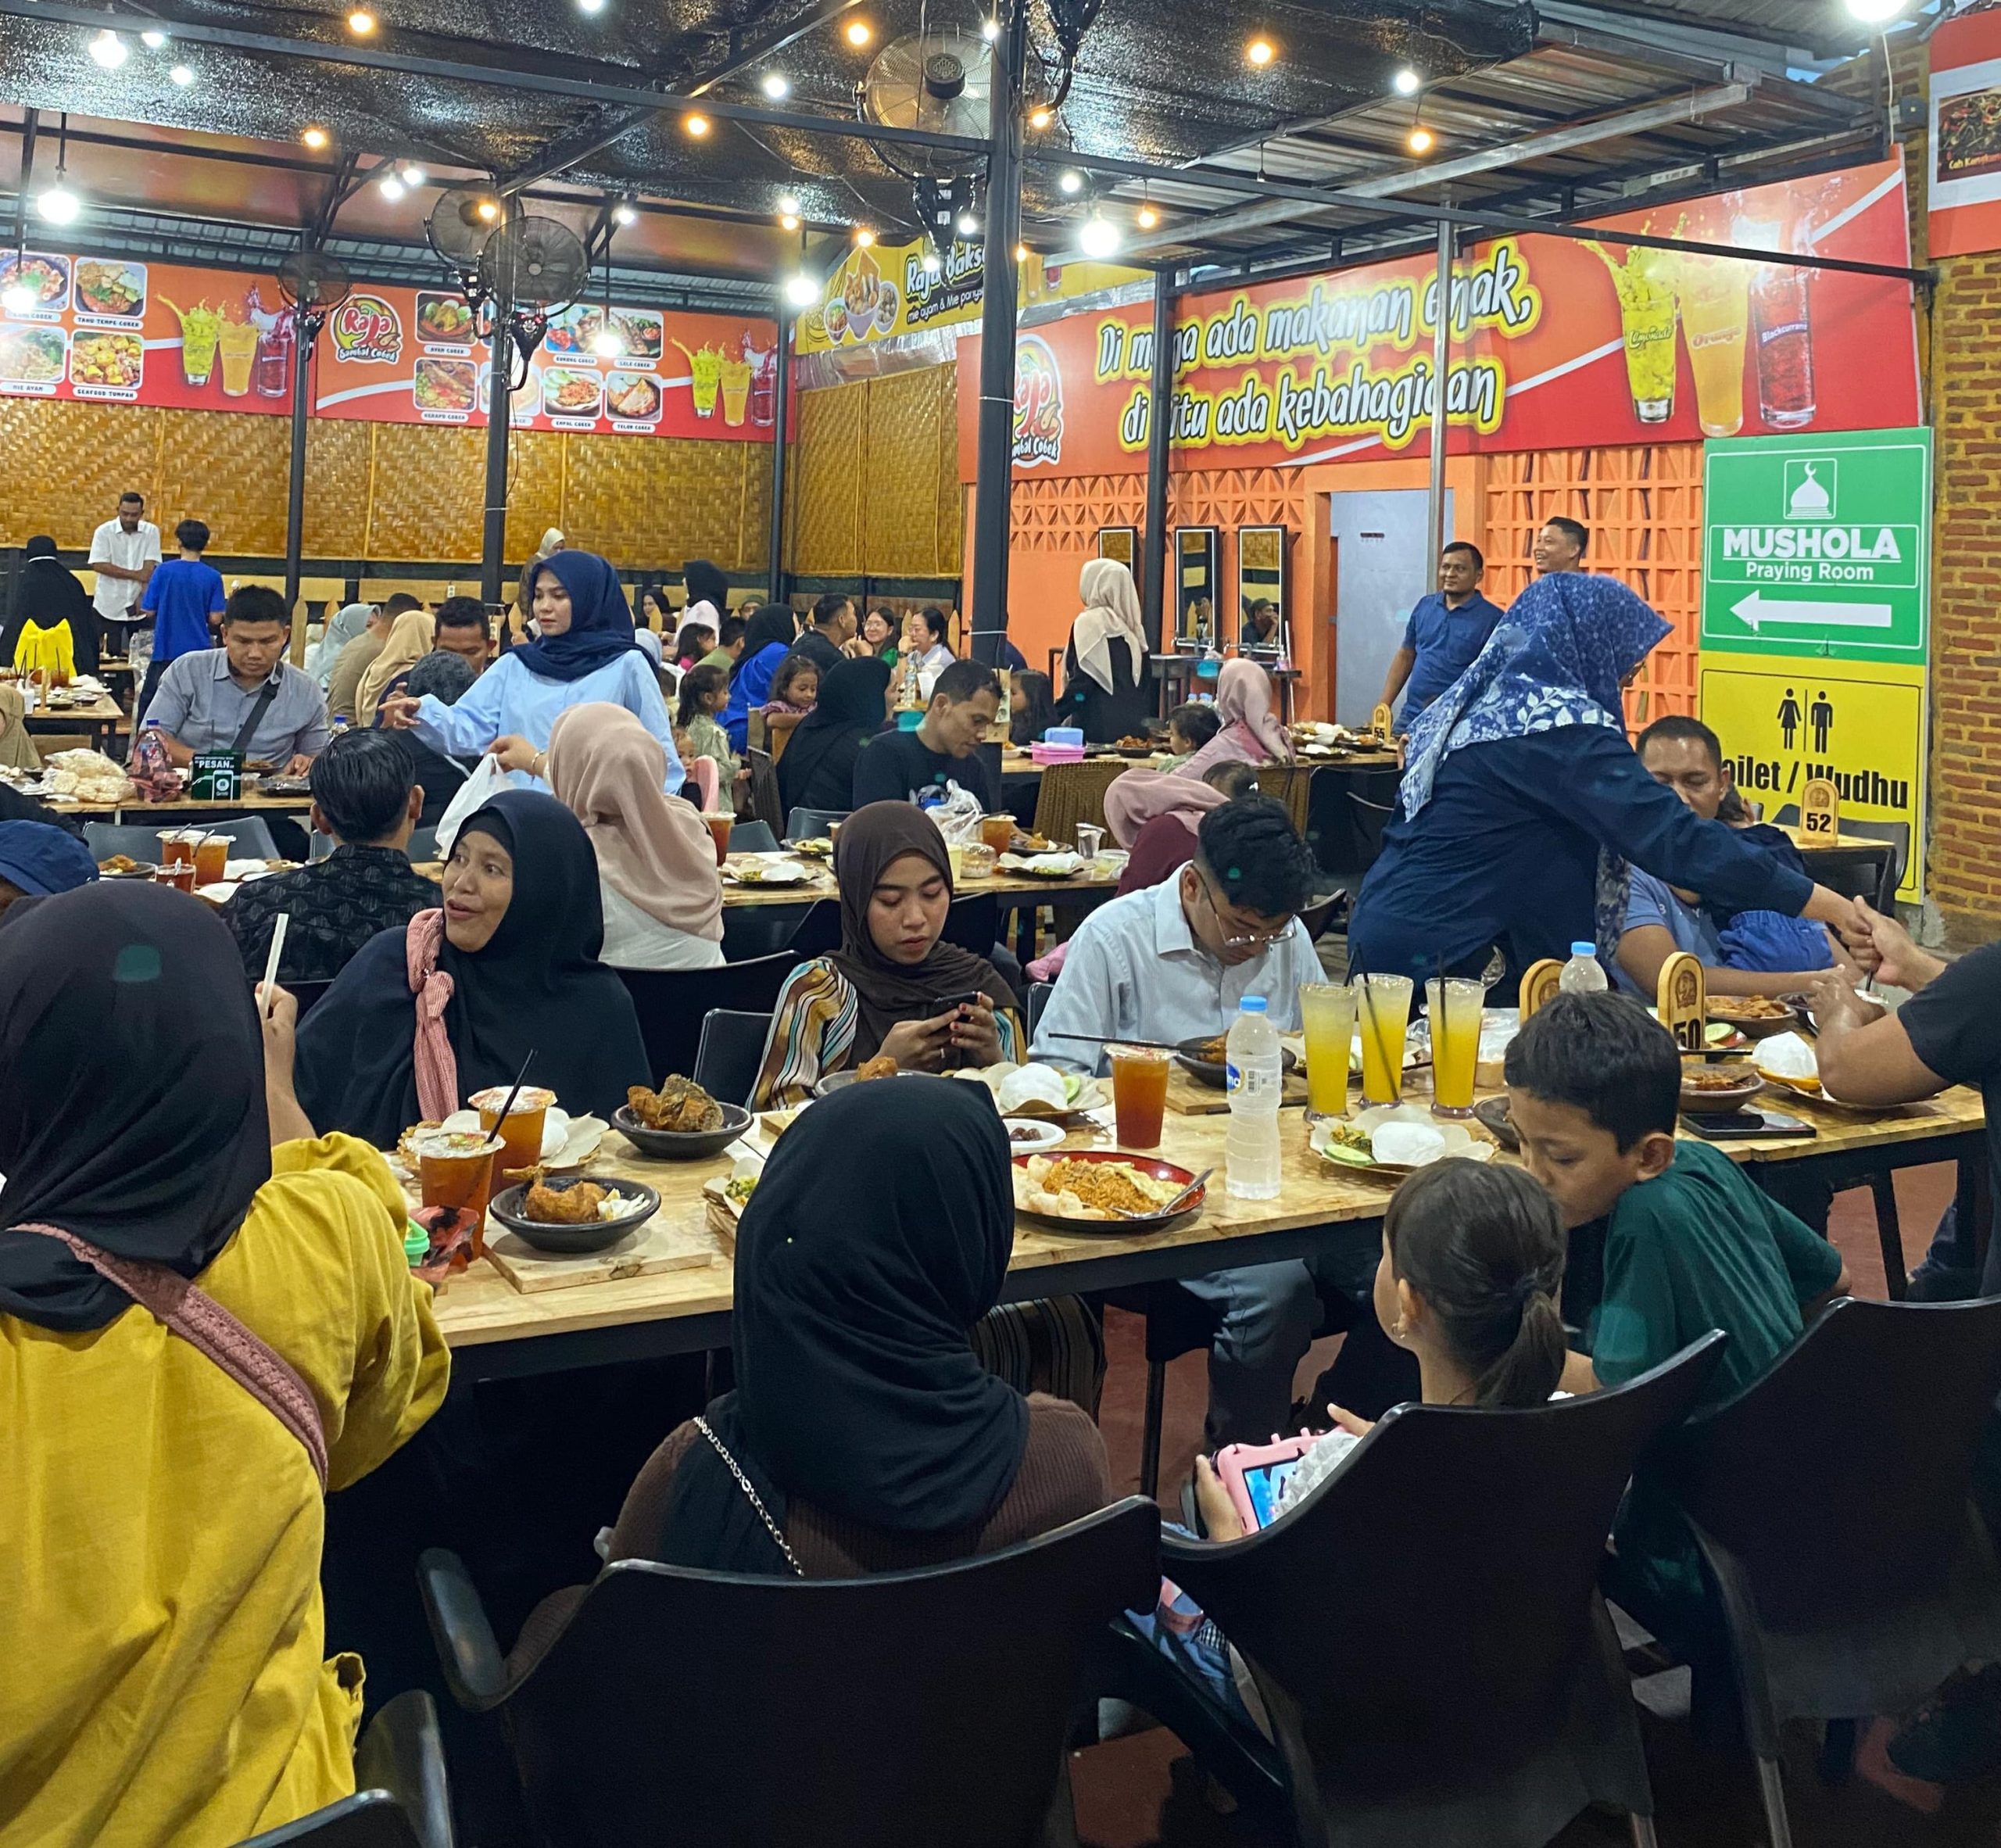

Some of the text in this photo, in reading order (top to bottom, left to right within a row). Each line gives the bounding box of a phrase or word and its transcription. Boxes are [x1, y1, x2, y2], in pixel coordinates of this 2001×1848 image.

[907, 309, 919, 323] mie
[920, 303, 939, 320] ayam
[940, 297, 946, 310] &
[342, 307, 392, 346] Raja
[1098, 324, 1124, 376] Di
[1129, 324, 1199, 374] mna
[1205, 300, 1258, 359] ada
[1264, 283, 1413, 354] makanan
[1691, 325, 1742, 347] Orange
[1014, 367, 1051, 437] aja
[1122, 391, 1148, 444] di
[1216, 378, 1269, 435] ada
[1033, 436, 1058, 459] Cobek
[1723, 527, 1901, 560] MUSHOLA
[1745, 561, 1874, 583] Praying Room
[199, 760, 230, 768] PESAN
[1721, 755, 1781, 792] oilet
[1806, 811, 1831, 833] 52
[1673, 1018, 1702, 1050] 50
